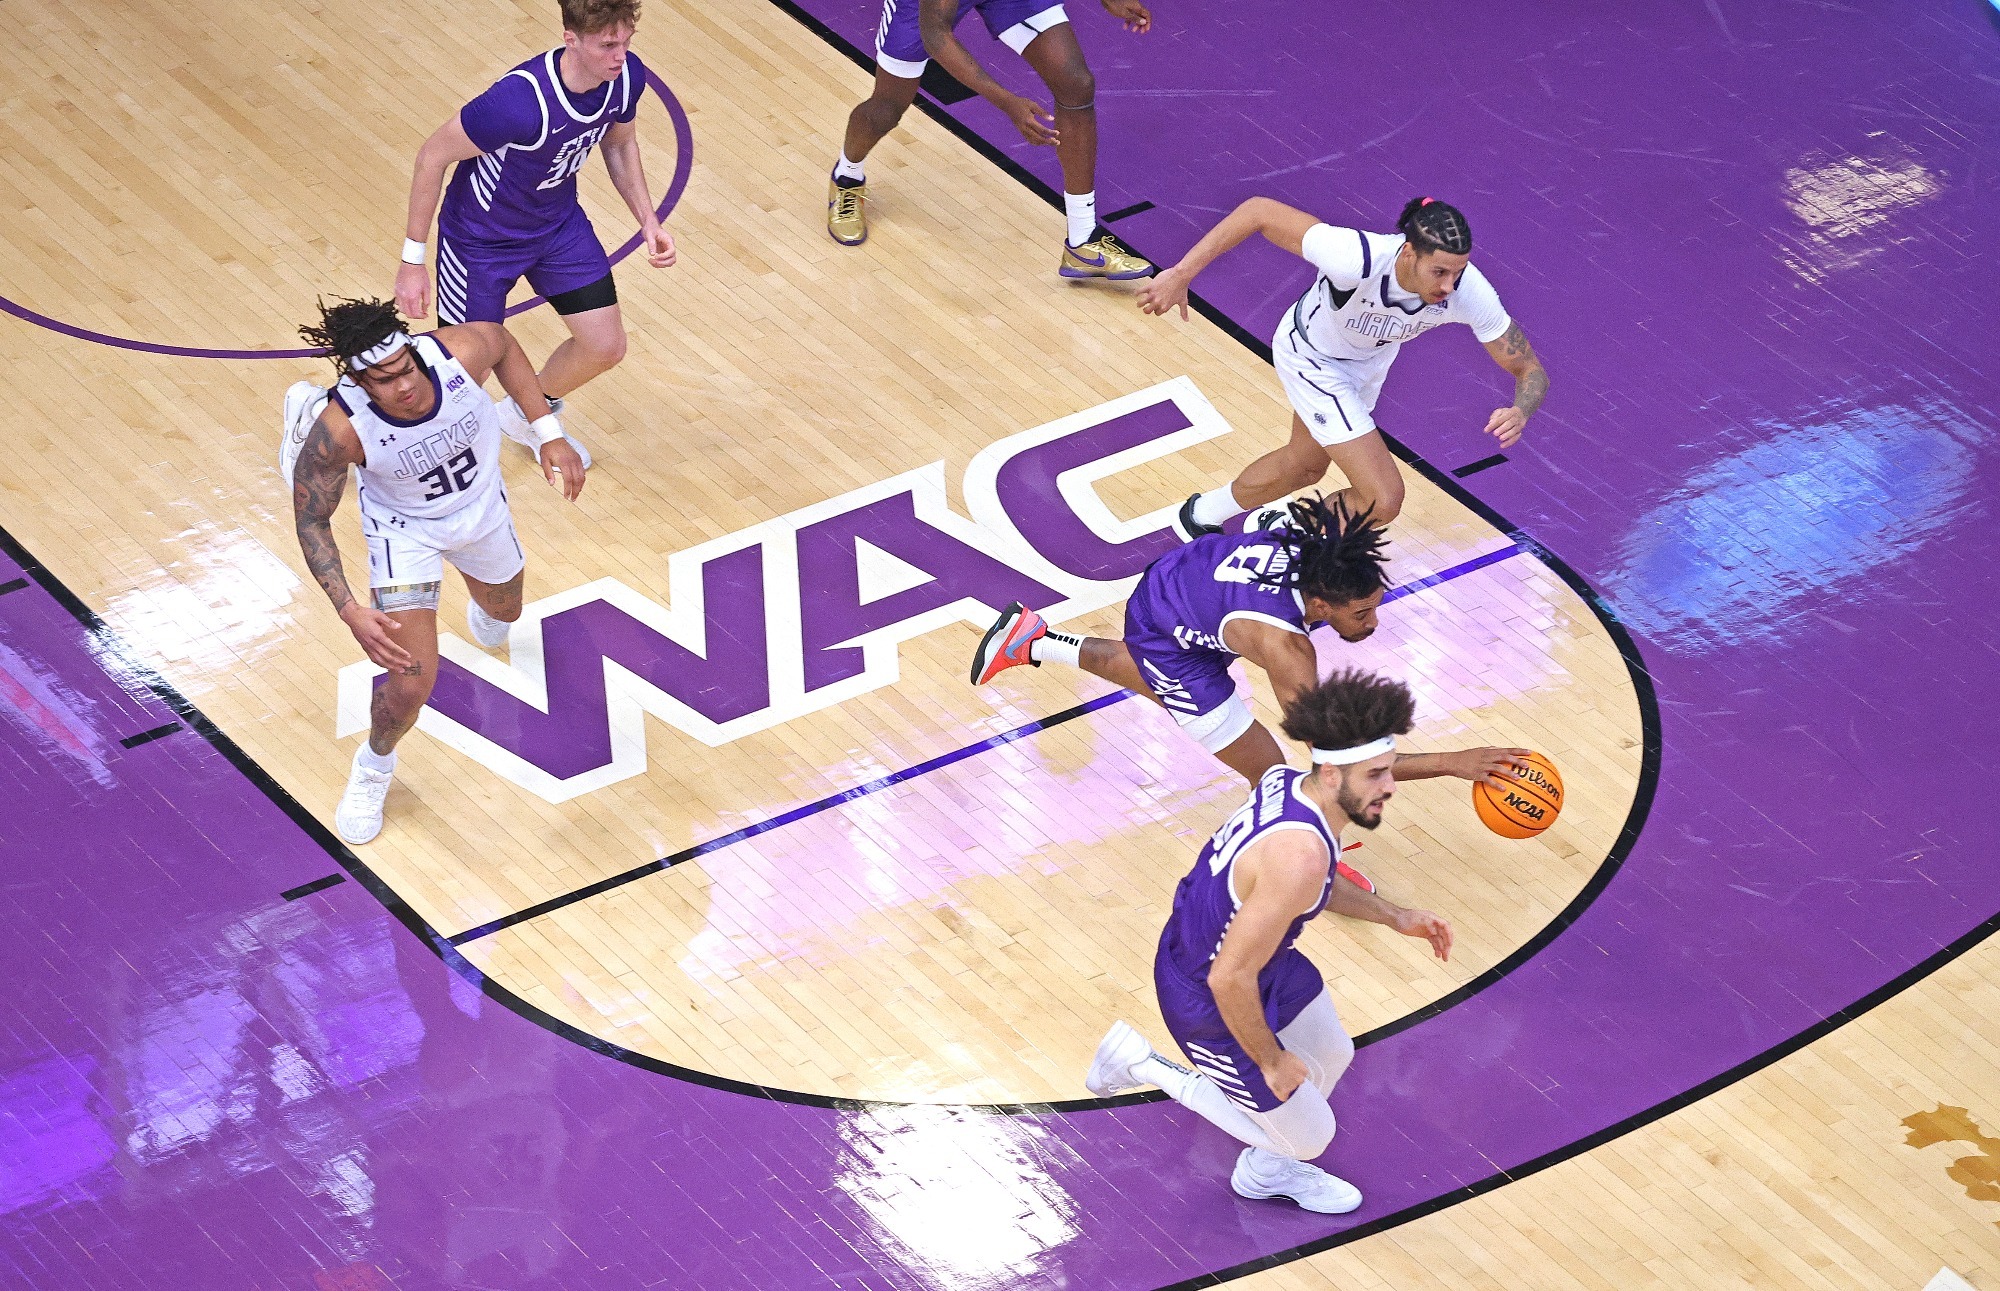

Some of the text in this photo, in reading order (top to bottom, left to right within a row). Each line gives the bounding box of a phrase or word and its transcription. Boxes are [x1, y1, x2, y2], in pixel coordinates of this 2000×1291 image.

[394, 411, 480, 479] JACKS
[418, 447, 477, 501] 32
[336, 376, 1232, 803] WAC
[1503, 791, 1546, 821] NCAA
